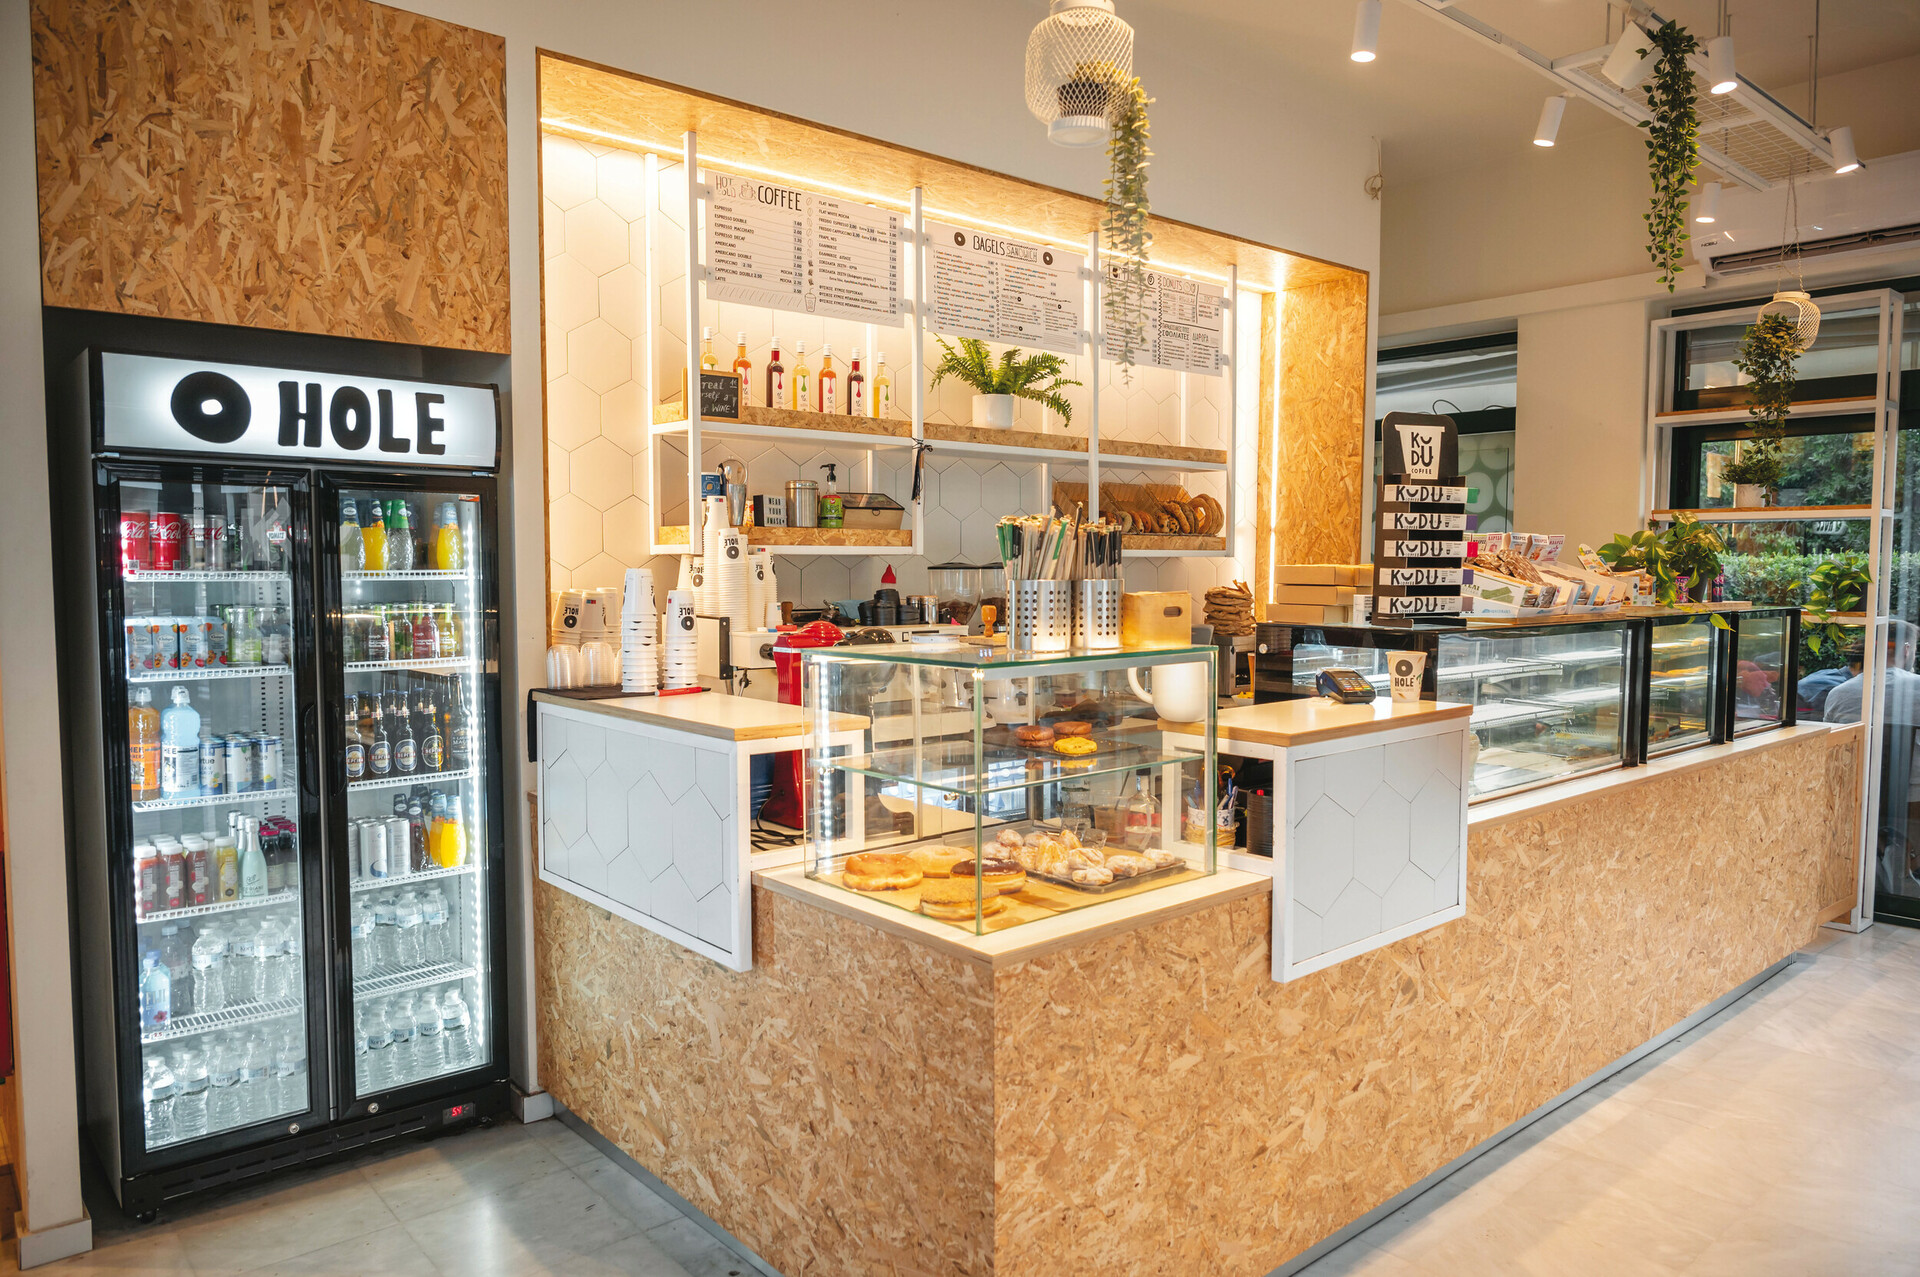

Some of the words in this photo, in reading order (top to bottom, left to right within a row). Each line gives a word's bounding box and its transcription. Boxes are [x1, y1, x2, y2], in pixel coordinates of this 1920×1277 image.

[715, 175, 734, 190] HOT
[758, 185, 802, 212] COFFEE
[714, 204, 733, 213] ESPRESSO
[714, 213, 733, 222] ESPRESSO
[714, 222, 733, 231] ESPRESSO
[734, 226, 755, 235] MACCHIATO
[714, 231, 733, 240] ESPRESSO
[714, 240, 737, 249] AMERICANO
[973, 235, 1005, 256] BAGELS
[1006, 246, 1038, 262] SANDWICH
[714, 249, 737, 258] AMERICANO
[737, 253, 752, 261] DOUBLE
[714, 258, 738, 267] CAPPUCCINO
[714, 267, 738, 276] CAPPUCCINO
[739, 270, 753, 278] DOUBLE
[714, 275, 727, 283] LATTE
[1162, 276, 1183, 291] DONUTS
[278, 380, 445, 455] HOLE
[1395, 485, 1443, 502] KUDU
[1394, 513, 1442, 530] KUDU
[724, 538, 739, 546] HOLE
[1396, 541, 1443, 557] KUDU
[1391, 569, 1438, 585] KUDU
[565, 606, 579, 615] HOLE
[1390, 597, 1438, 613] KUDU
[679, 607, 695, 616] HOLE
[1394, 677, 1414, 687] HOLE
